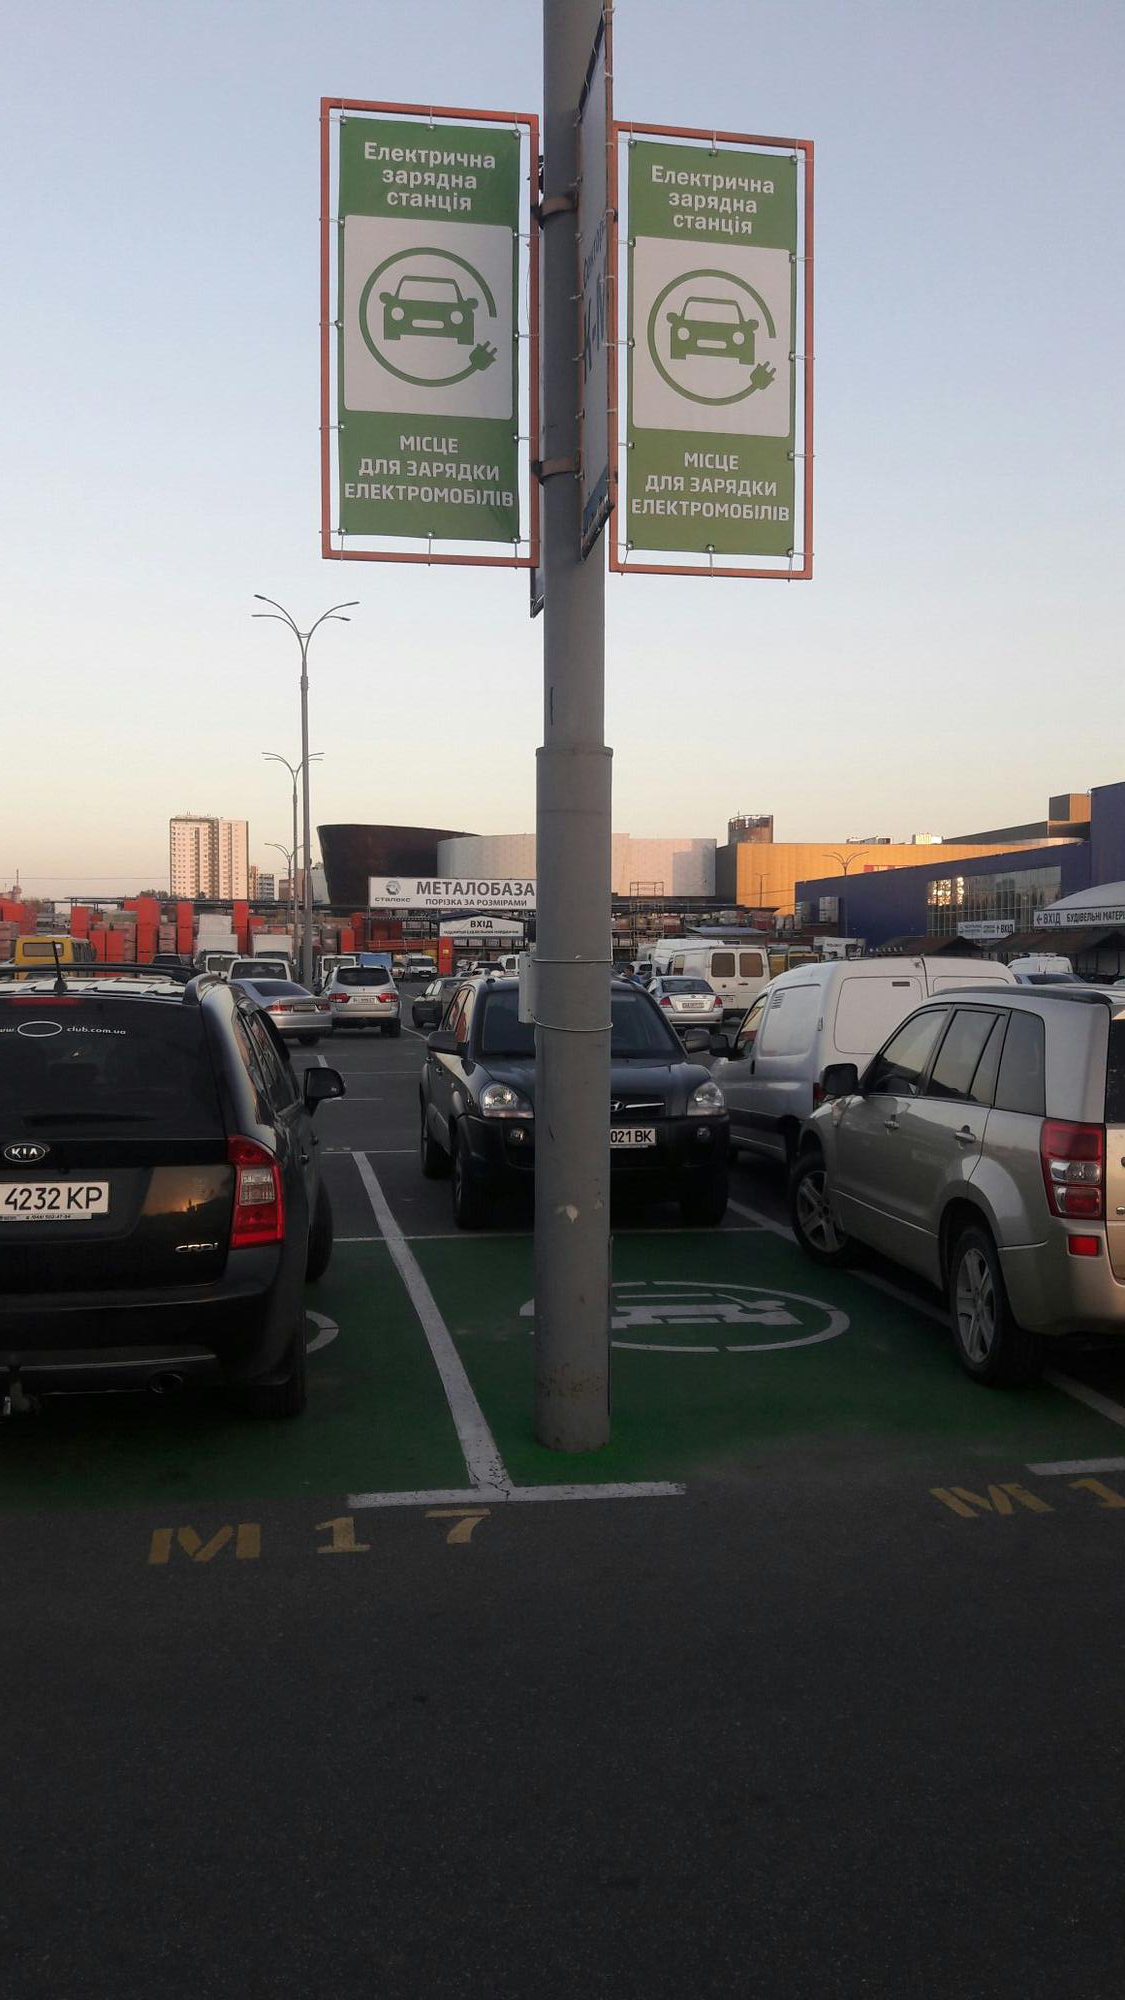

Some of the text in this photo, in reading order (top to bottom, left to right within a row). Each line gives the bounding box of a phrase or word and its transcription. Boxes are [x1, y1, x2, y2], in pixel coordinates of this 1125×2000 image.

[364, 141, 496, 169] Електрична
[382, 169, 477, 190] зарядна
[651, 164, 775, 194] Електрична
[387, 191, 472, 212] станція
[668, 192, 757, 213] зарядна
[673, 214, 753, 235] станція
[400, 435, 459, 455] МІСЦЕ
[358, 458, 500, 482] ДЛЯ ЗАРЯДКИ
[684, 452, 739, 471] МІСЦЕ
[344, 483, 514, 507] ЕЛЕКТРОМОБІЛІВ
[645, 474, 777, 497] ДЛЯ ЗАРЯДКИ
[631, 498, 790, 521] ЕЛЕКТРОМОБІЛІВ
[416, 881, 535, 896] МЕТАЛОБАЗА
[425, 898, 462, 906] ПОРІЗКА
[477, 899, 528, 907] РОЗМІРАМИ
[470, 920, 493, 929] ВХІД
[1043, 912, 1061, 926] ВХІД
[1066, 911, 1102, 924] БУДІВЕЛЬНІ
[66, 1025, 126, 1035] club.com.ua
[634, 1130, 653, 1143] BK
[11, 1147, 38, 1159] KIA
[4, 1186, 103, 1211] 4232 KP
